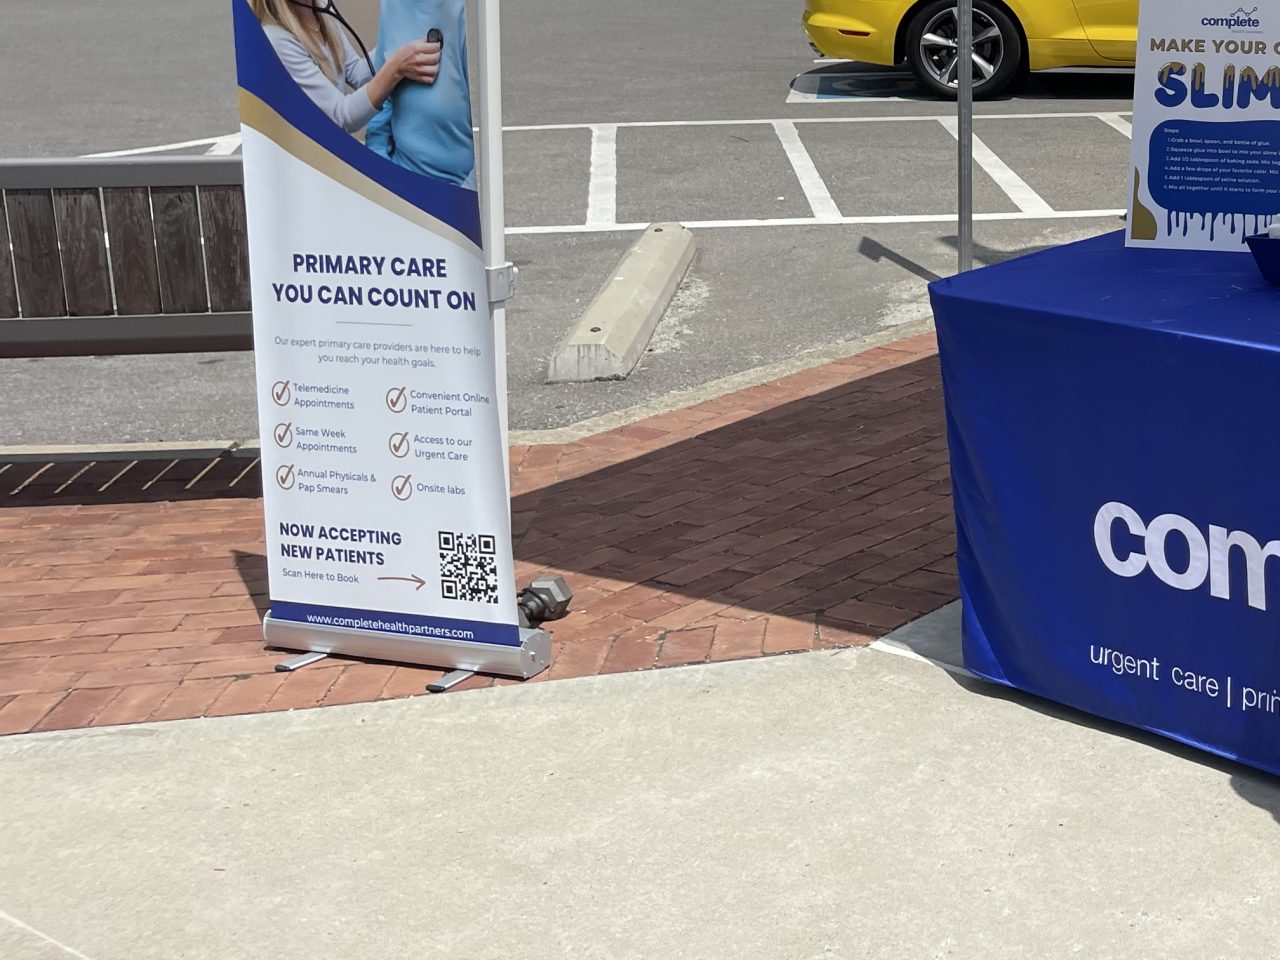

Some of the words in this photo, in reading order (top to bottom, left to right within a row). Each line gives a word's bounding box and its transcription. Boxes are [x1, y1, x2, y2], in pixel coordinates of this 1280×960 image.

[1201, 15, 1260, 29] complete
[1150, 38, 1206, 53] MAKE
[1211, 40, 1267, 55] YOUR
[292, 253, 385, 275] PRIMARY
[390, 257, 447, 278] CARE
[272, 283, 313, 304] YOU
[317, 285, 363, 306] CAN
[367, 287, 442, 309] COUNT
[446, 290, 477, 311] ON
[274, 336, 290, 346] Our
[290, 338, 317, 349] expert
[318, 339, 351, 351] primary
[352, 342, 372, 351] care
[373, 341, 413, 353] providers
[414, 345, 429, 353] are
[430, 344, 450, 354] here
[452, 345, 462, 355] to
[463, 345, 482, 357] help
[318, 354, 335, 364] you
[335, 353, 359, 364] reach
[361, 357, 380, 366] your
[382, 355, 410, 366] health
[411, 357, 436, 368] goals.
[293, 382, 350, 395] Telemedicine
[294, 398, 355, 410] Appointments
[410, 390, 460, 402] Convenient
[463, 392, 490, 404] Online
[411, 404, 443, 415] Patient
[445, 406, 473, 417] Portal
[295, 426, 320, 437] Same
[321, 428, 346, 438] Week
[296, 441, 358, 454] Appointments
[414, 434, 444, 445] Access
[446, 437, 455, 446] to
[457, 439, 473, 447] our
[414, 449, 446, 461] Urgent
[447, 451, 469, 461] Care
[297, 468, 328, 479] Annual
[329, 470, 369, 482] Physicals
[370, 473, 377, 483] &
[298, 482, 315, 493] Pap
[316, 484, 349, 495] Smears
[416, 483, 446, 494] Onsite
[447, 485, 466, 495] labs
[279, 522, 315, 539] NOW
[318, 525, 402, 546] ACCEPTING
[280, 543, 312, 560] NEW
[315, 547, 385, 566] PATIENTS
[282, 568, 303, 579] Scan
[304, 570, 325, 581] Here
[326, 572, 336, 582] to
[337, 573, 360, 584] Book
[306, 613, 474, 640] www.completehealthpartners.com
[1090, 644, 1160, 681] urgent
[1171, 666, 1219, 697] care
